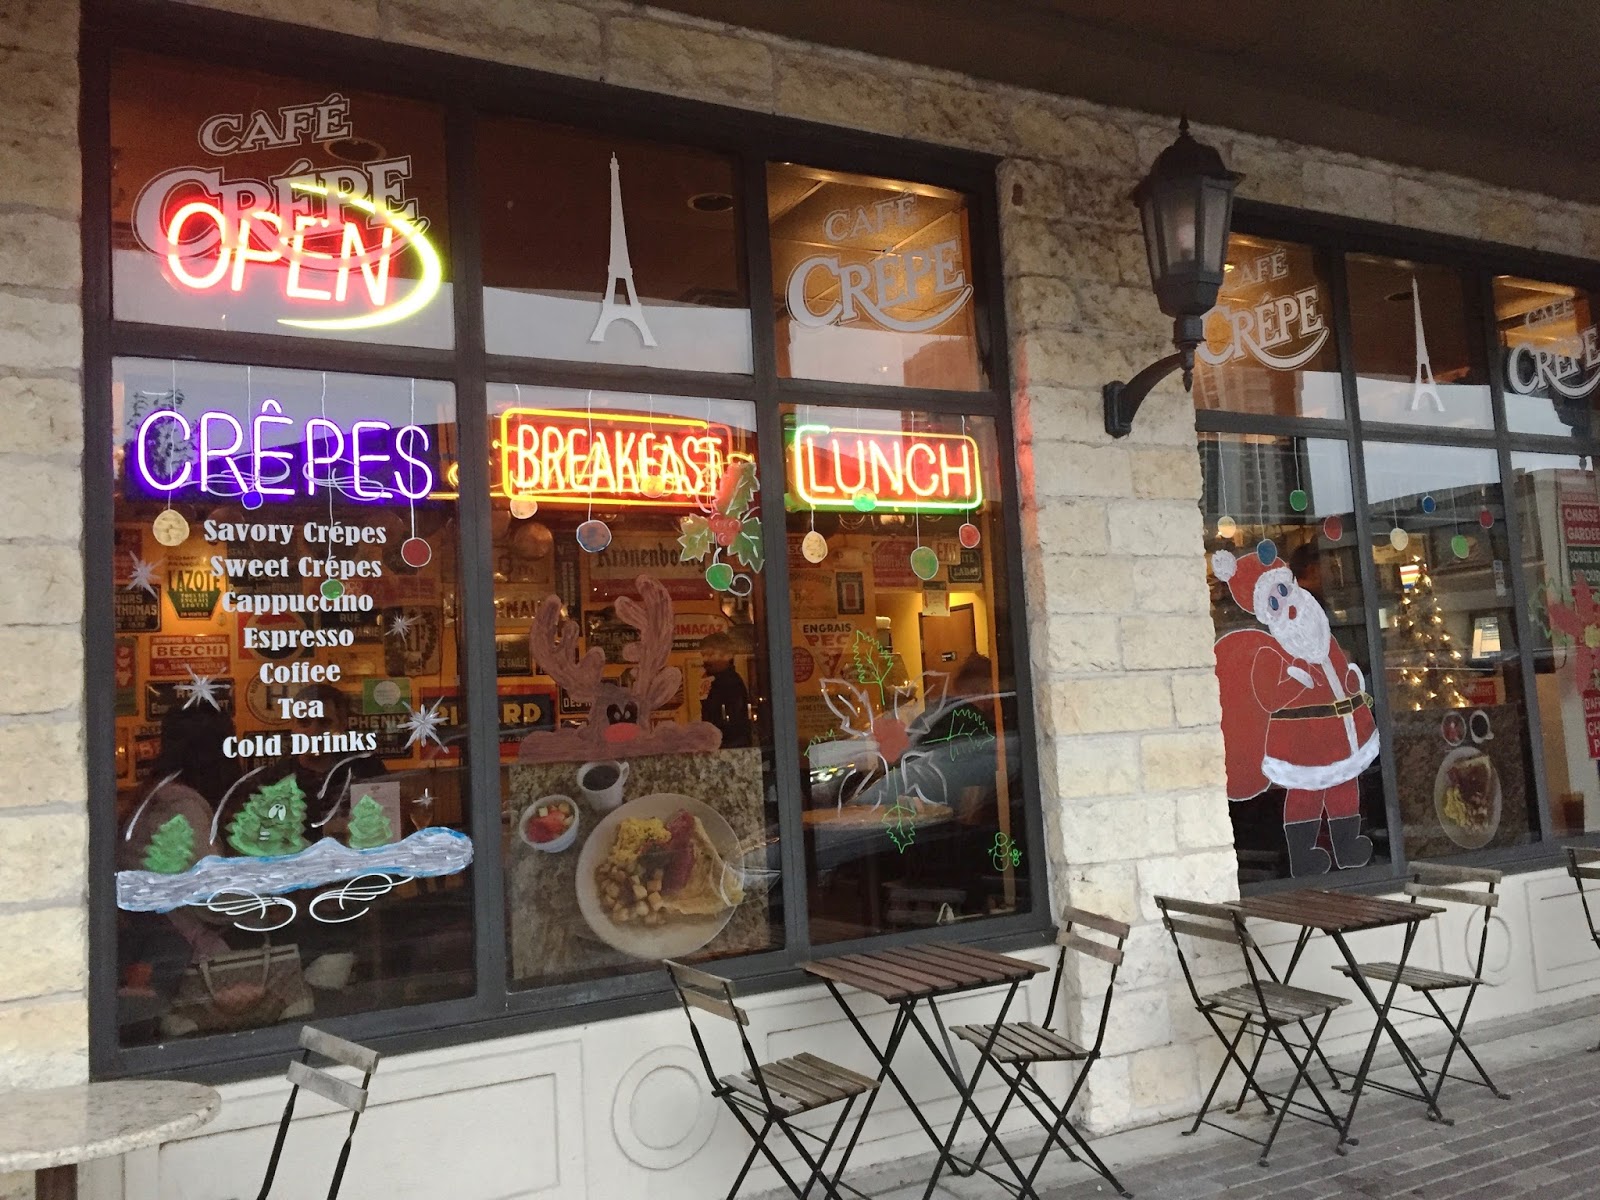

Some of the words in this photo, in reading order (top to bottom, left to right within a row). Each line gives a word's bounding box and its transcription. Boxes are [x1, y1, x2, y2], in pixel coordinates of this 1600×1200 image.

[198, 93, 352, 156] CAFÉ
[823, 189, 918, 242] CAFÉ
[167, 201, 394, 307] OPEN
[1240, 245, 1289, 287] AFÉ
[137, 399, 433, 500] CRÊPES
[517, 424, 723, 497] BREAKFAST
[806, 436, 972, 497] LUNCH
[1565, 508, 1599, 522] CHASSE
[204, 520, 294, 545] Savory
[210, 556, 289, 577] Sweet
[597, 544, 706, 573] Kronenbog
[222, 591, 374, 615] Cappuccino
[340, 613, 361, 622] RUE
[803, 623, 852, 634] ENGRAIS
[243, 627, 355, 651] Espresso
[259, 662, 341, 684] Coffee
[277, 697, 325, 720] Tea
[222, 736, 282, 758] Cold
[290, 731, 377, 756] Drinks
